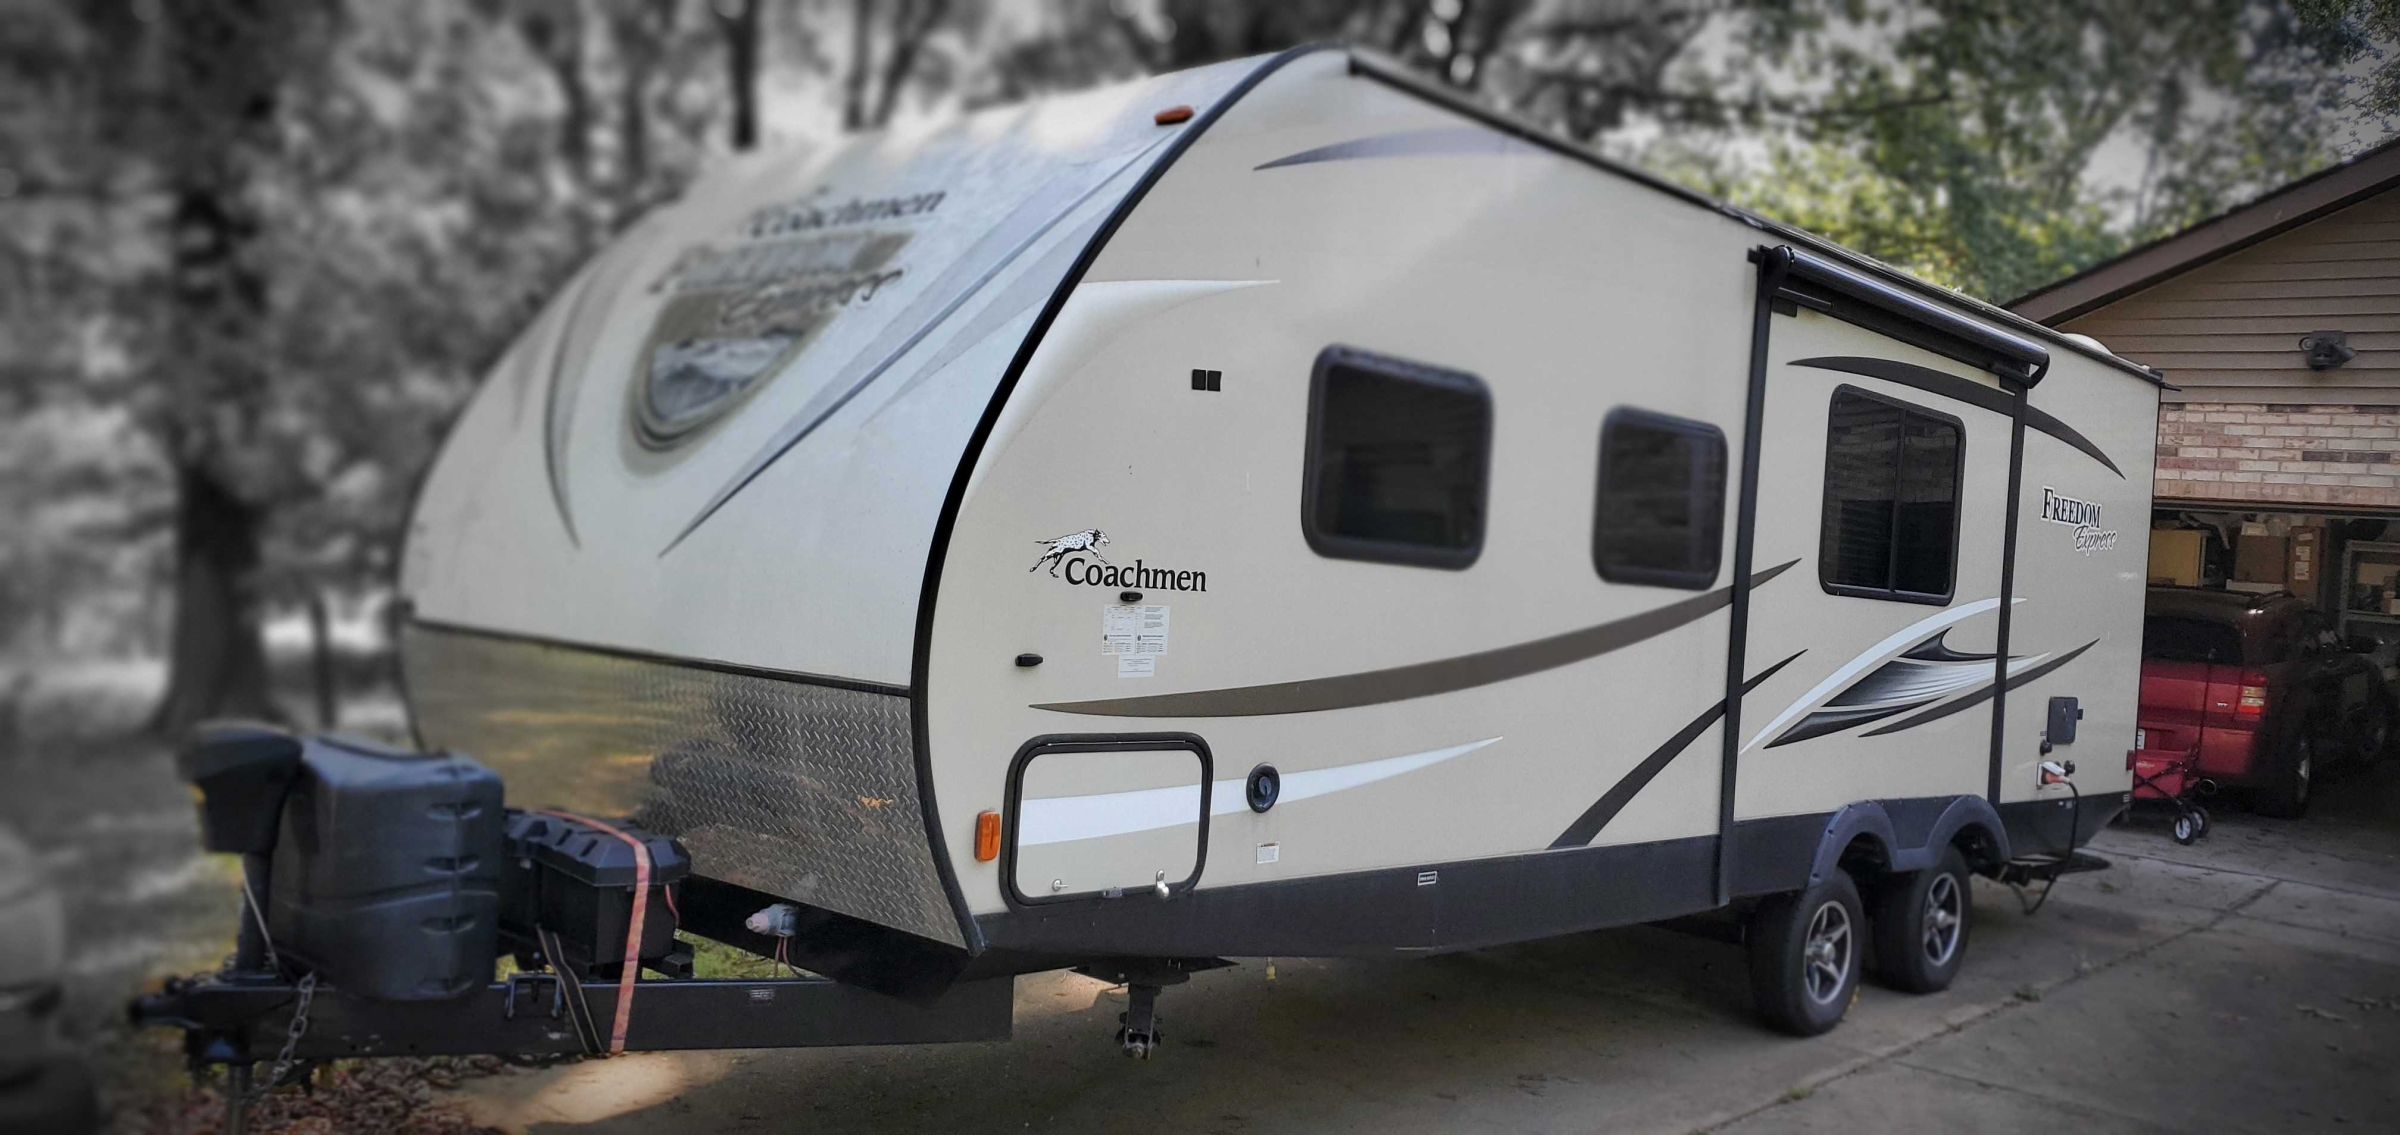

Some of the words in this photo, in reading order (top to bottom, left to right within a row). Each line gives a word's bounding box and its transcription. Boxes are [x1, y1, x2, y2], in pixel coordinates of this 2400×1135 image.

[2041, 487, 2101, 529] FREEDOM
[2073, 525, 2117, 555] Express
[1065, 558, 1207, 592] Coachmen
